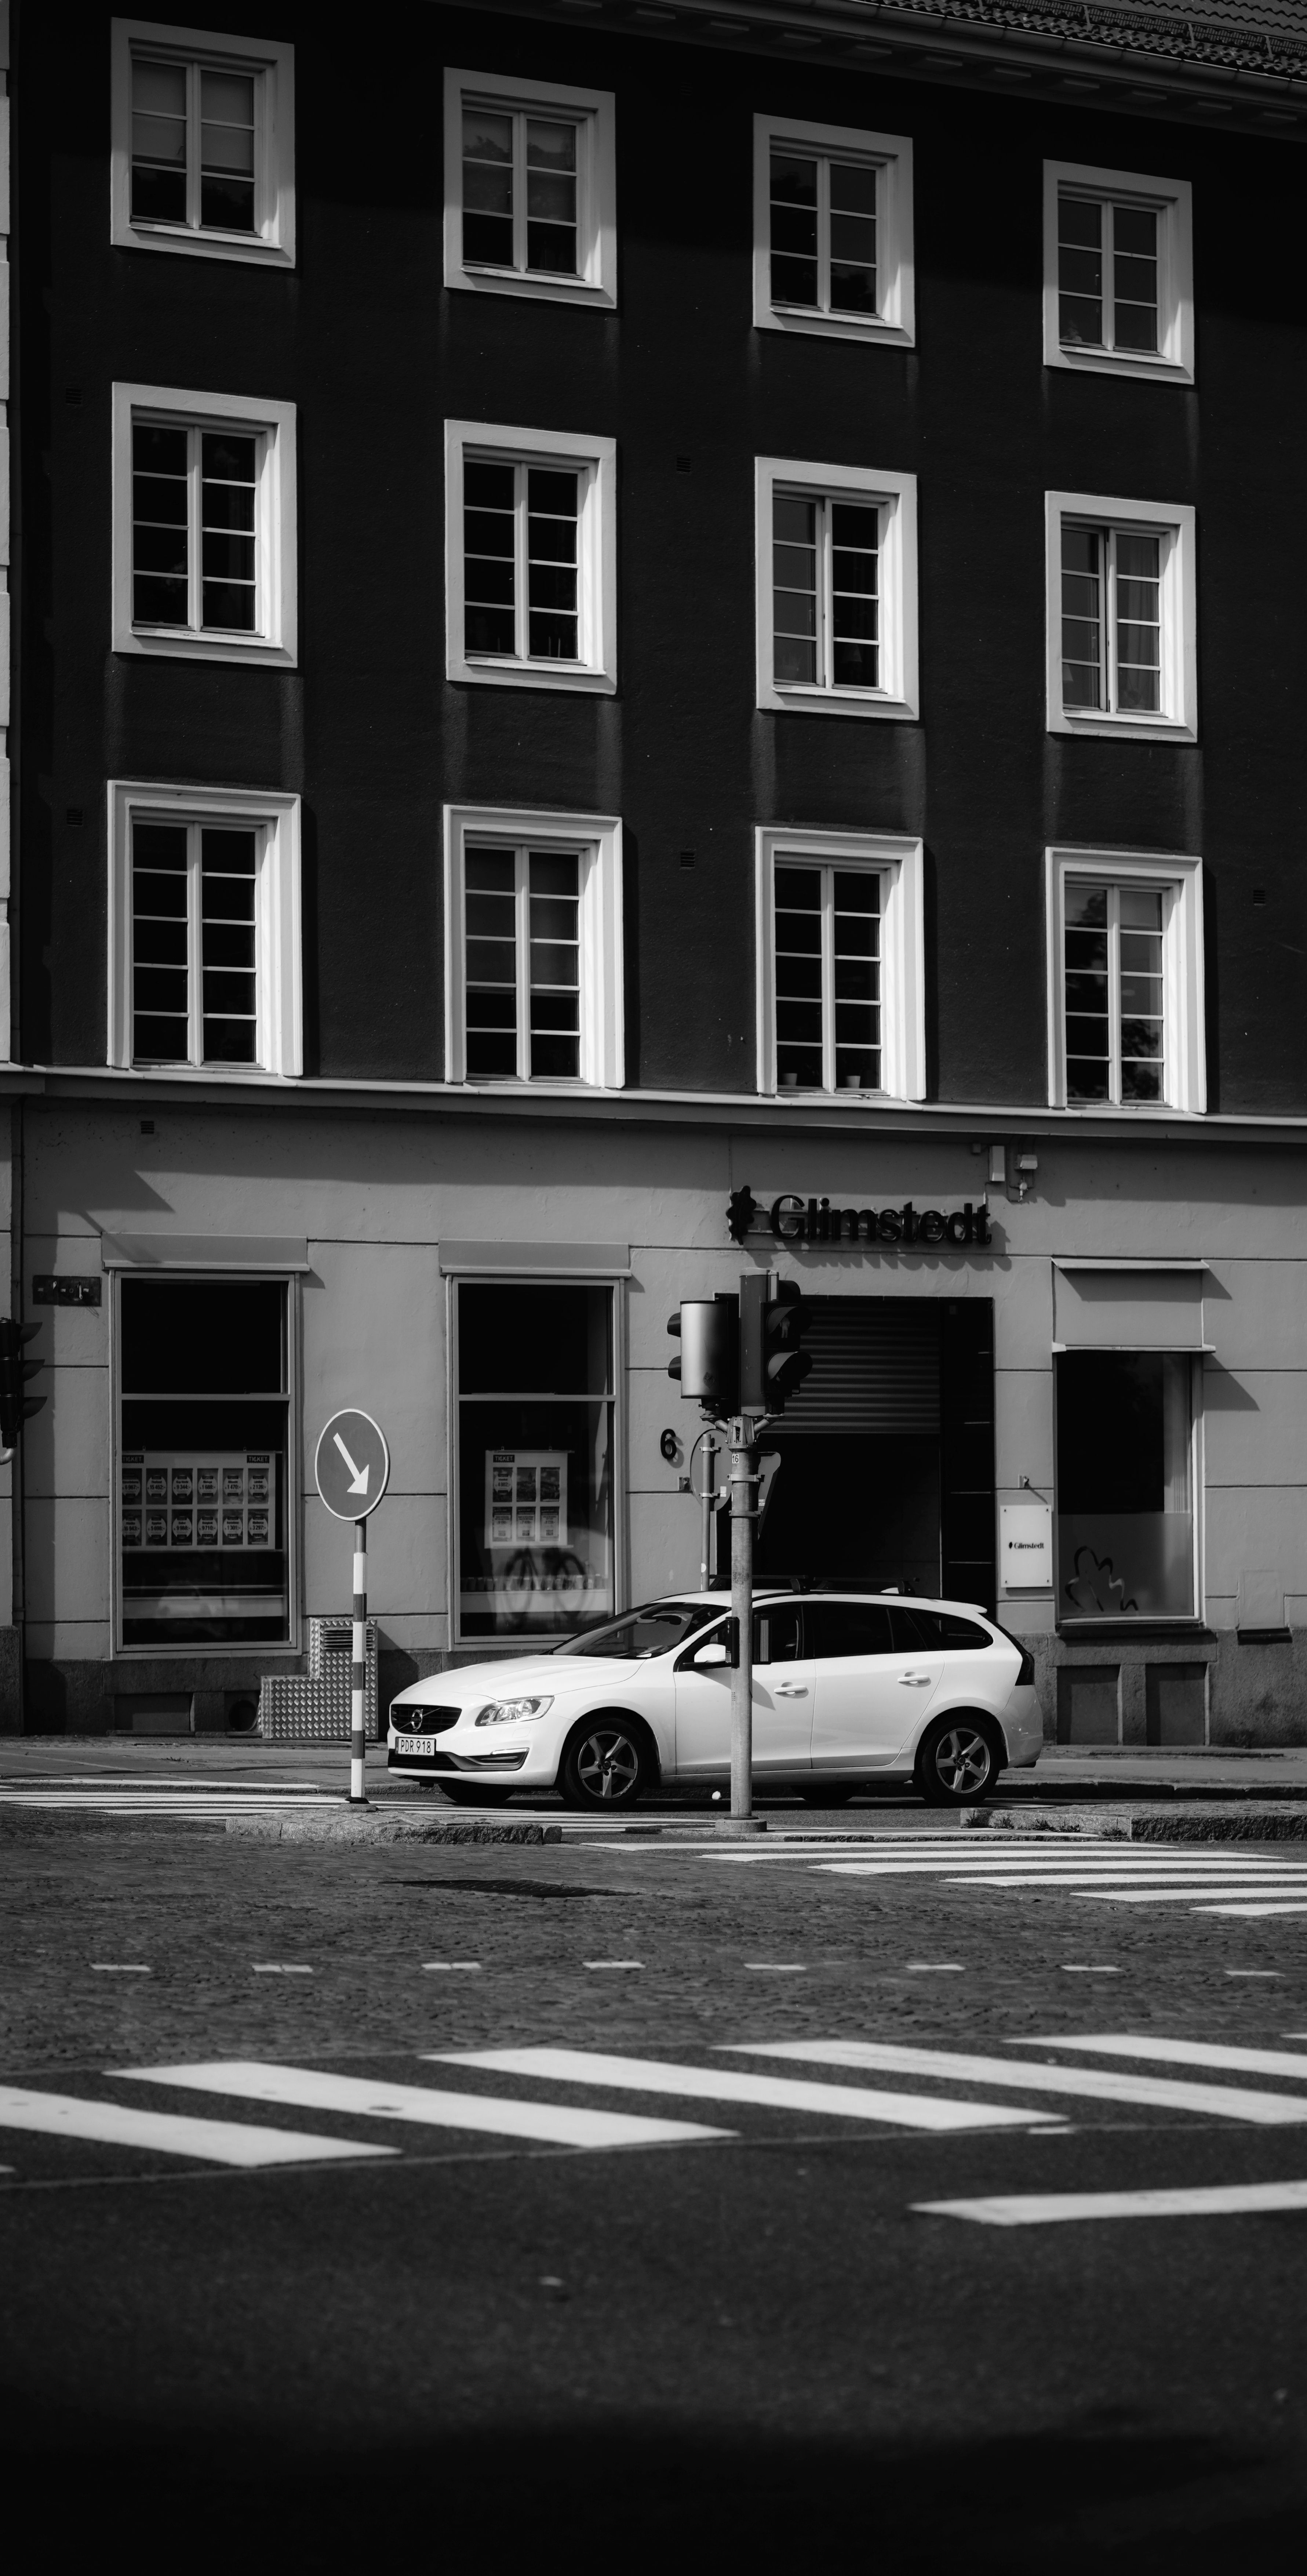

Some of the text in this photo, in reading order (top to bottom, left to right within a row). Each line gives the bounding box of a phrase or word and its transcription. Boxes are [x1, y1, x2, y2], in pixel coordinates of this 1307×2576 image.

[770, 1194, 992, 1245] Glimstedt
[660, 1429, 677, 1459] 6
[401, 1739, 431, 1753] PDR 918
